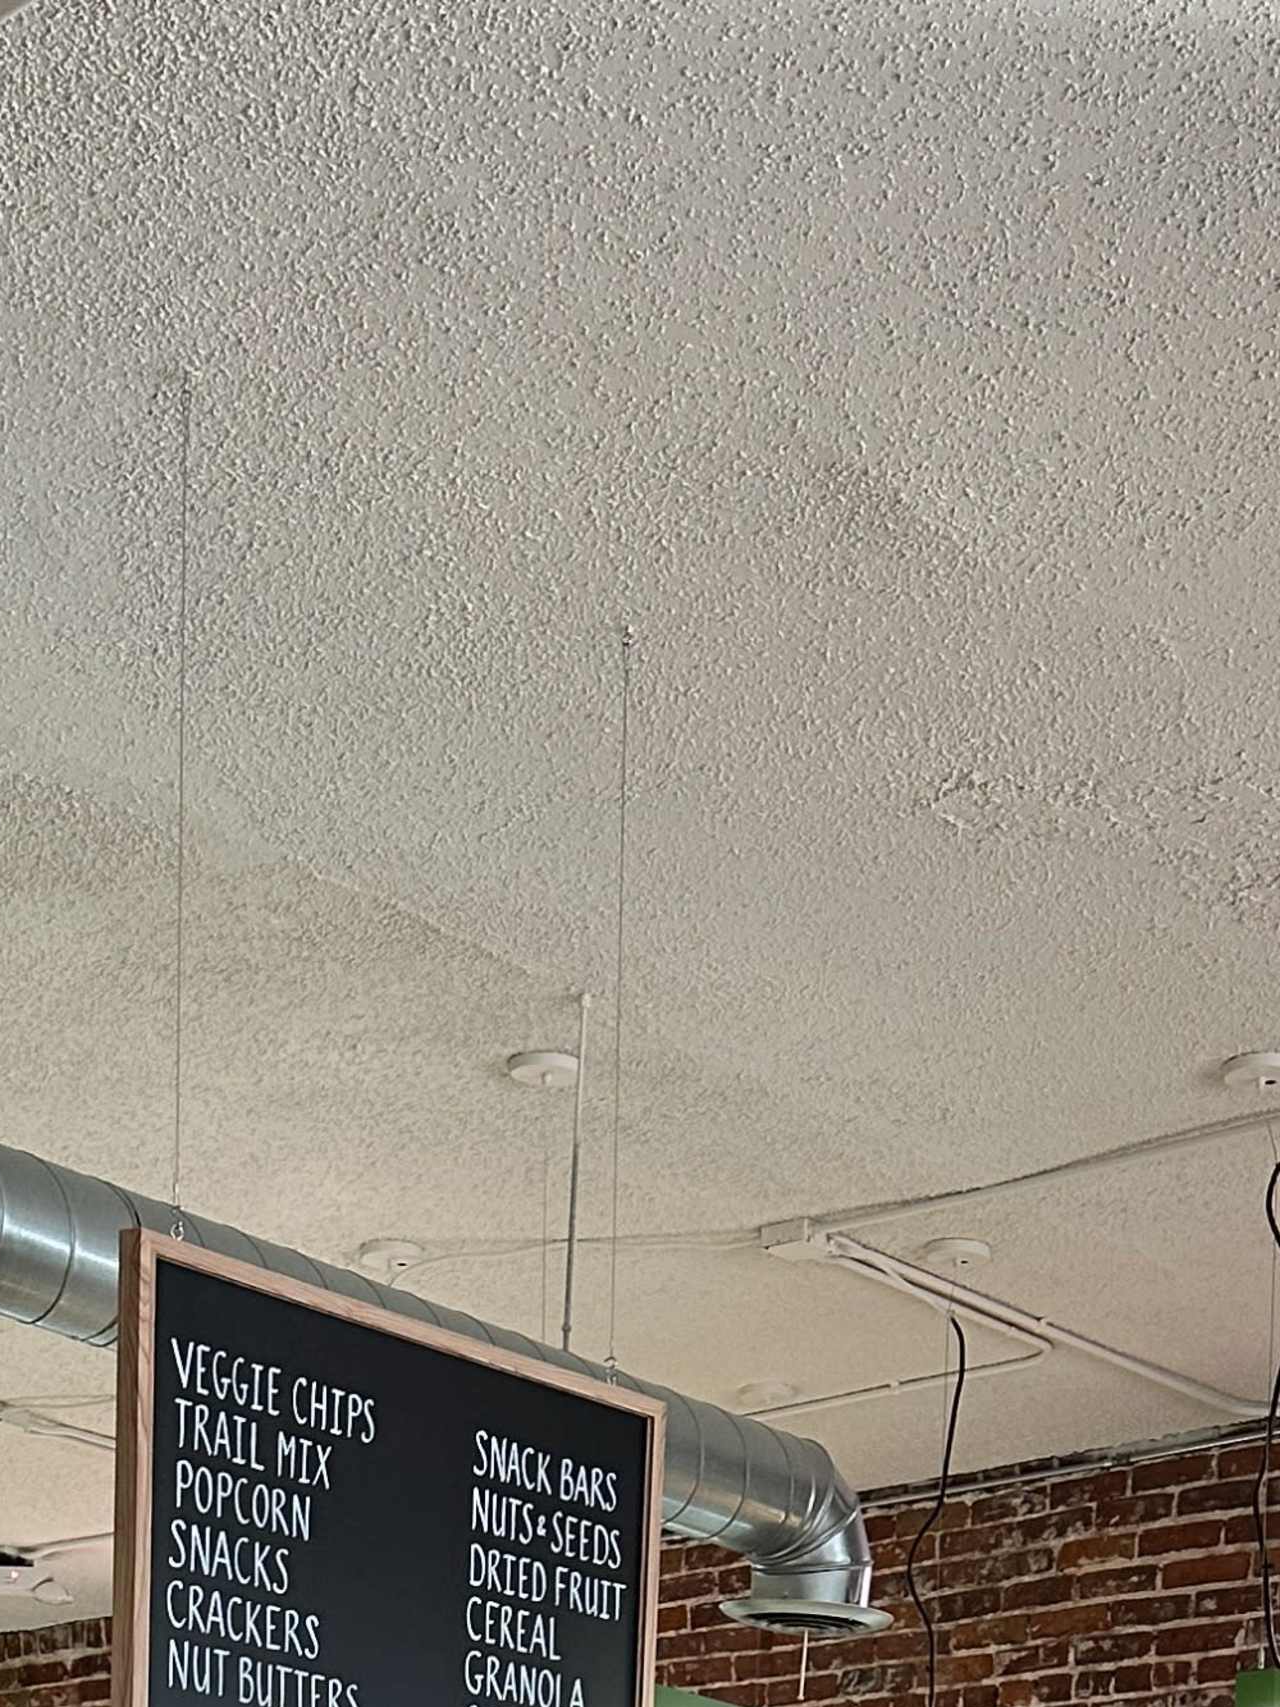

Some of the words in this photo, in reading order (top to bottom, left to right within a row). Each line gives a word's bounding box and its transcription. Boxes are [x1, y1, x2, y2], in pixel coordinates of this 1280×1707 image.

[171, 1338, 281, 1417] VEGGIE
[292, 1377, 376, 1443] CHIPS
[174, 1399, 264, 1472] TRAIL
[277, 1431, 333, 1490] MIX
[472, 1430, 552, 1497] SNACK
[560, 1460, 617, 1512] BARS
[175, 1460, 312, 1542] POPCORN
[168, 1520, 290, 1595] SNACKS
[469, 1542, 547, 1603] DRIED
[556, 1566, 627, 1621] FRUIT
[166, 1580, 320, 1660] CRACKERS
[466, 1596, 561, 1662] CEREAL
[168, 1640, 230, 1698] NUT
